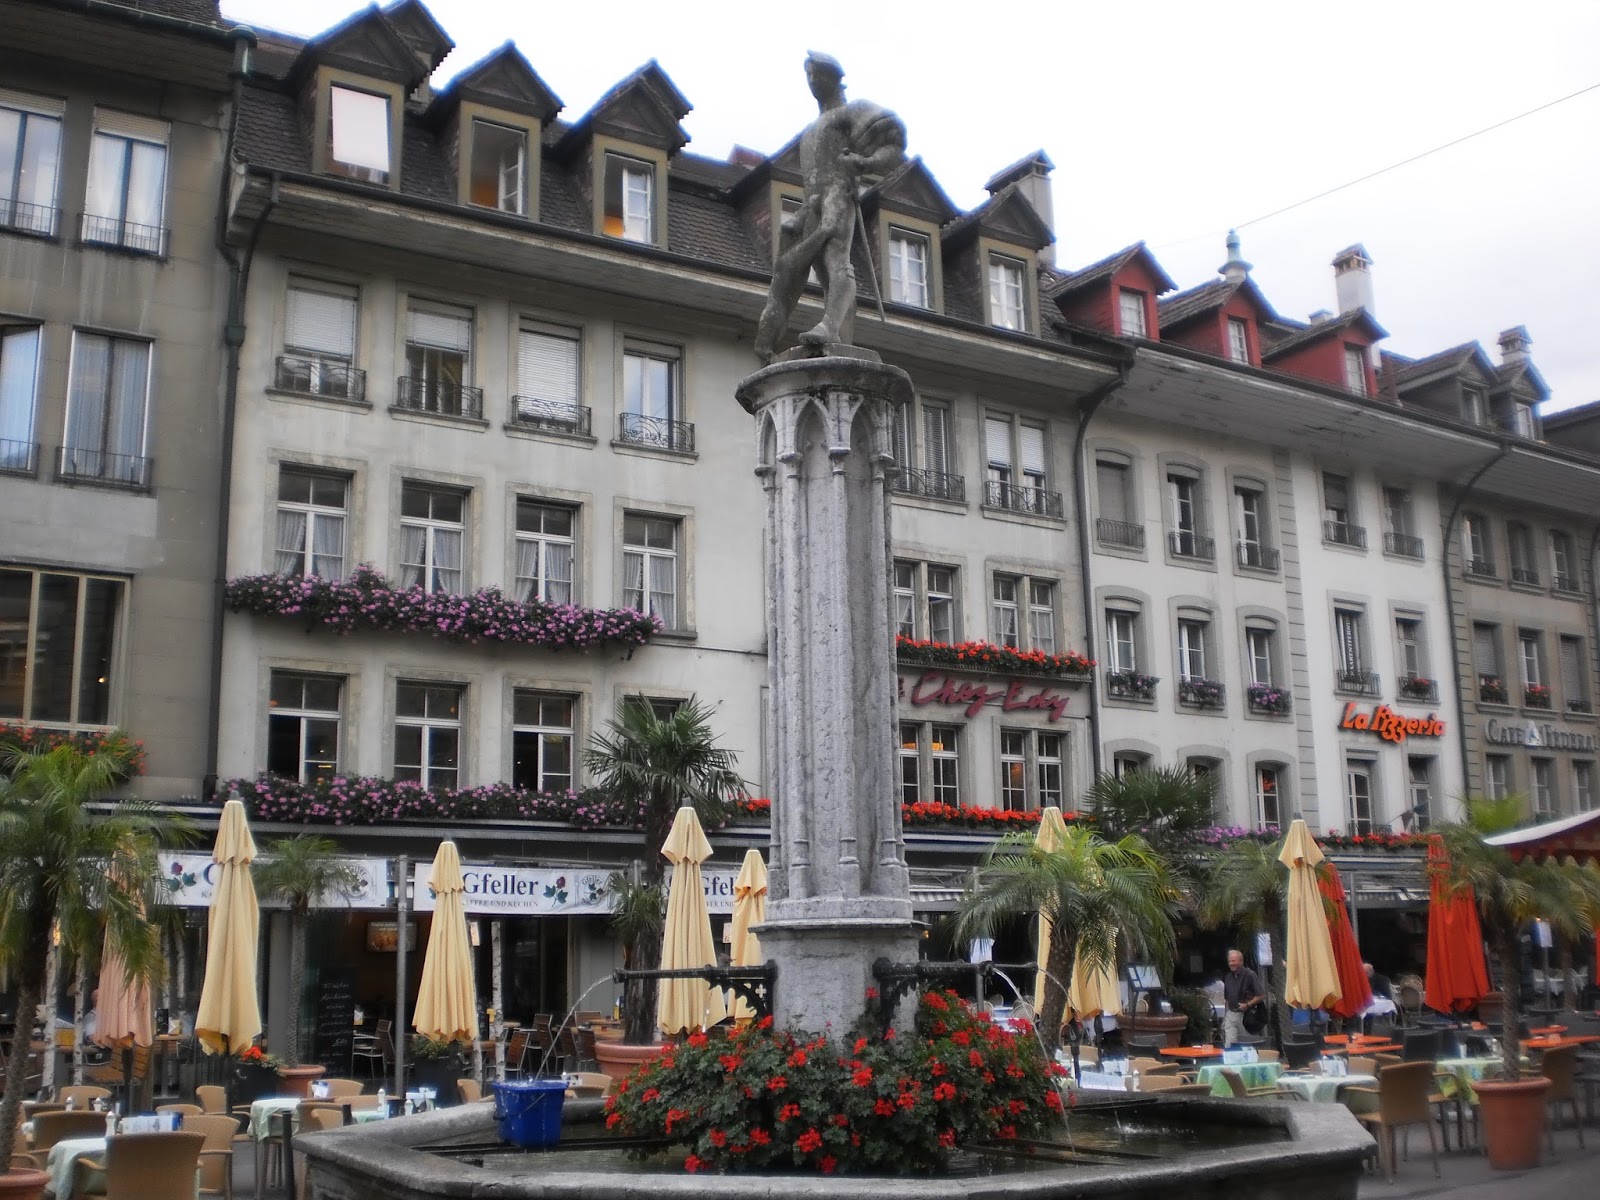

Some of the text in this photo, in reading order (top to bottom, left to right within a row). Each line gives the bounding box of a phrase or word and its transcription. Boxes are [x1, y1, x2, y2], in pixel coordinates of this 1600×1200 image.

[911, 669, 1004, 718] Chez
[1002, 681, 1070, 723] Edy
[1338, 701, 1446, 744] La Pizzeria
[462, 872, 539, 896] Gfeller
[701, 876, 738, 896] Gfel
